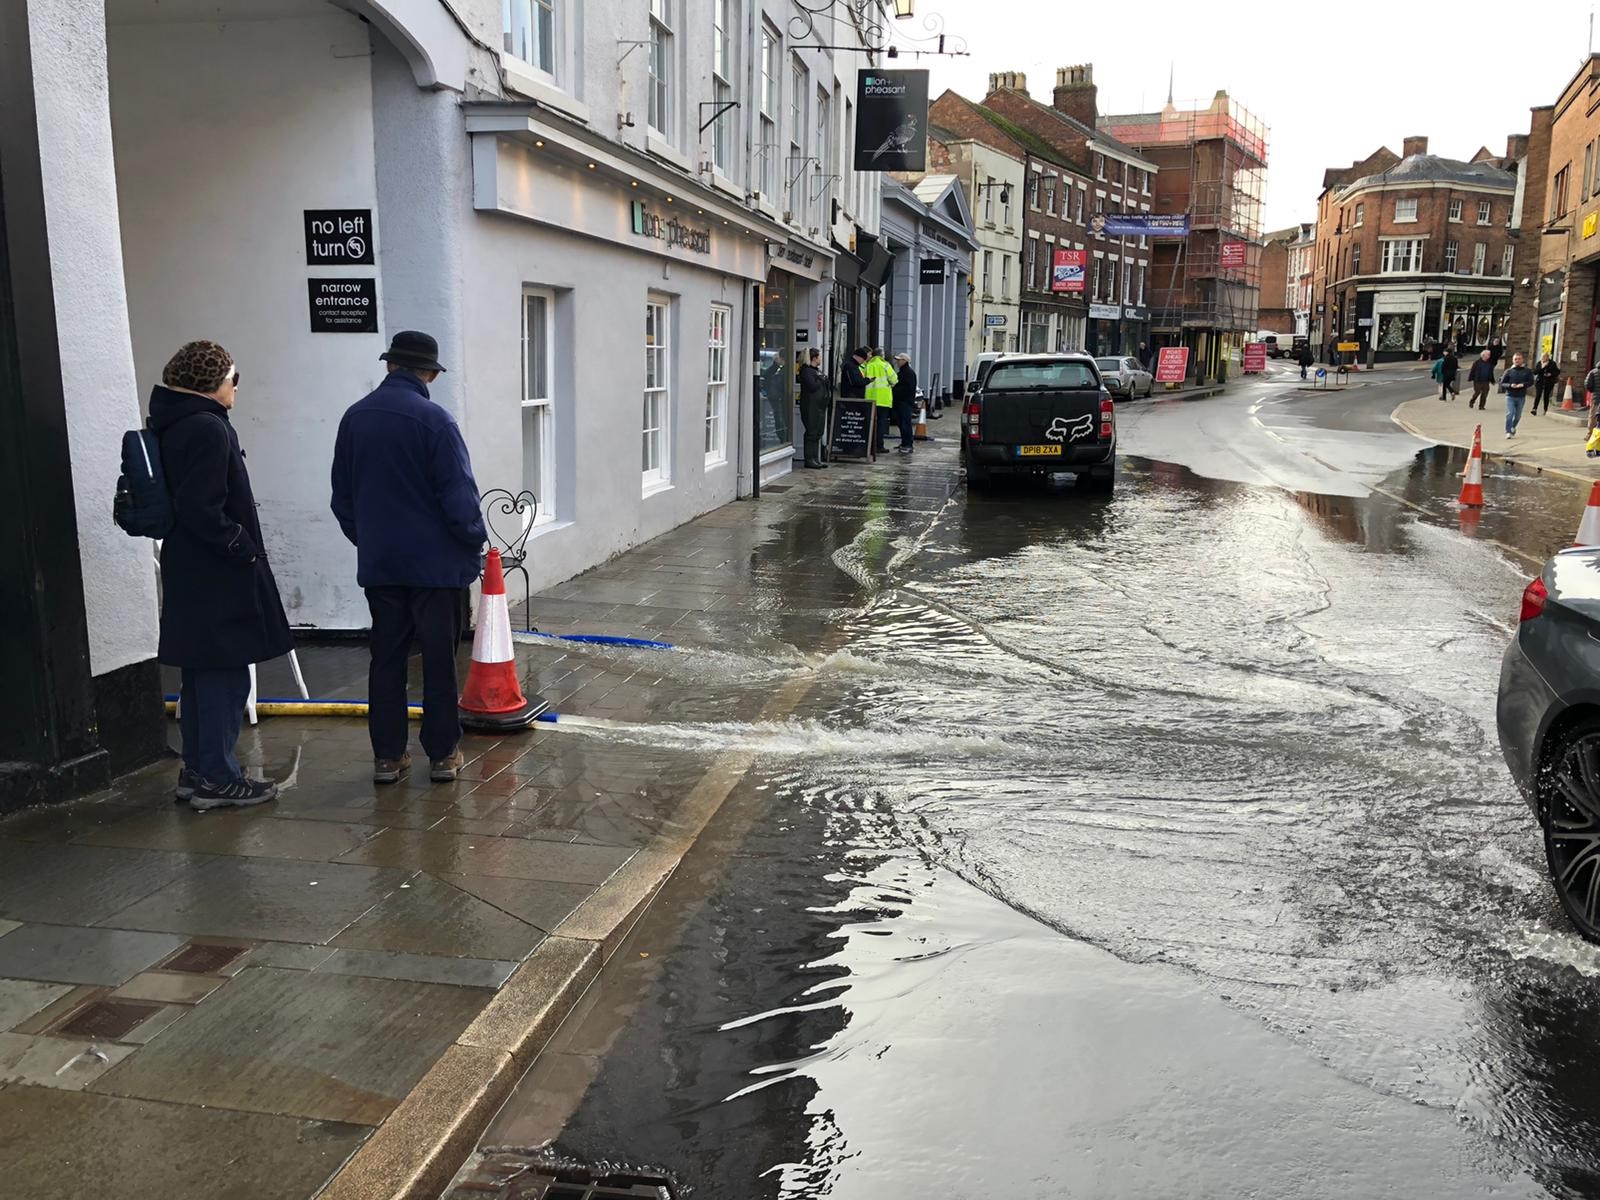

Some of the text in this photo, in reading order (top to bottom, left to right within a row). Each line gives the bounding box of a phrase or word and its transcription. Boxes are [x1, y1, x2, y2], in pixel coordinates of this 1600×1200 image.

[865, 85, 906, 95] pheasant
[312, 216, 365, 234] no left
[312, 239, 345, 256] turn
[1061, 251, 1080, 260] TSR
[321, 284, 361, 293] narrow
[315, 295, 370, 306] entrance
[341, 309, 367, 318] reception
[334, 316, 362, 324] assistance
[1023, 446, 1059, 454] DP18 ZXA
